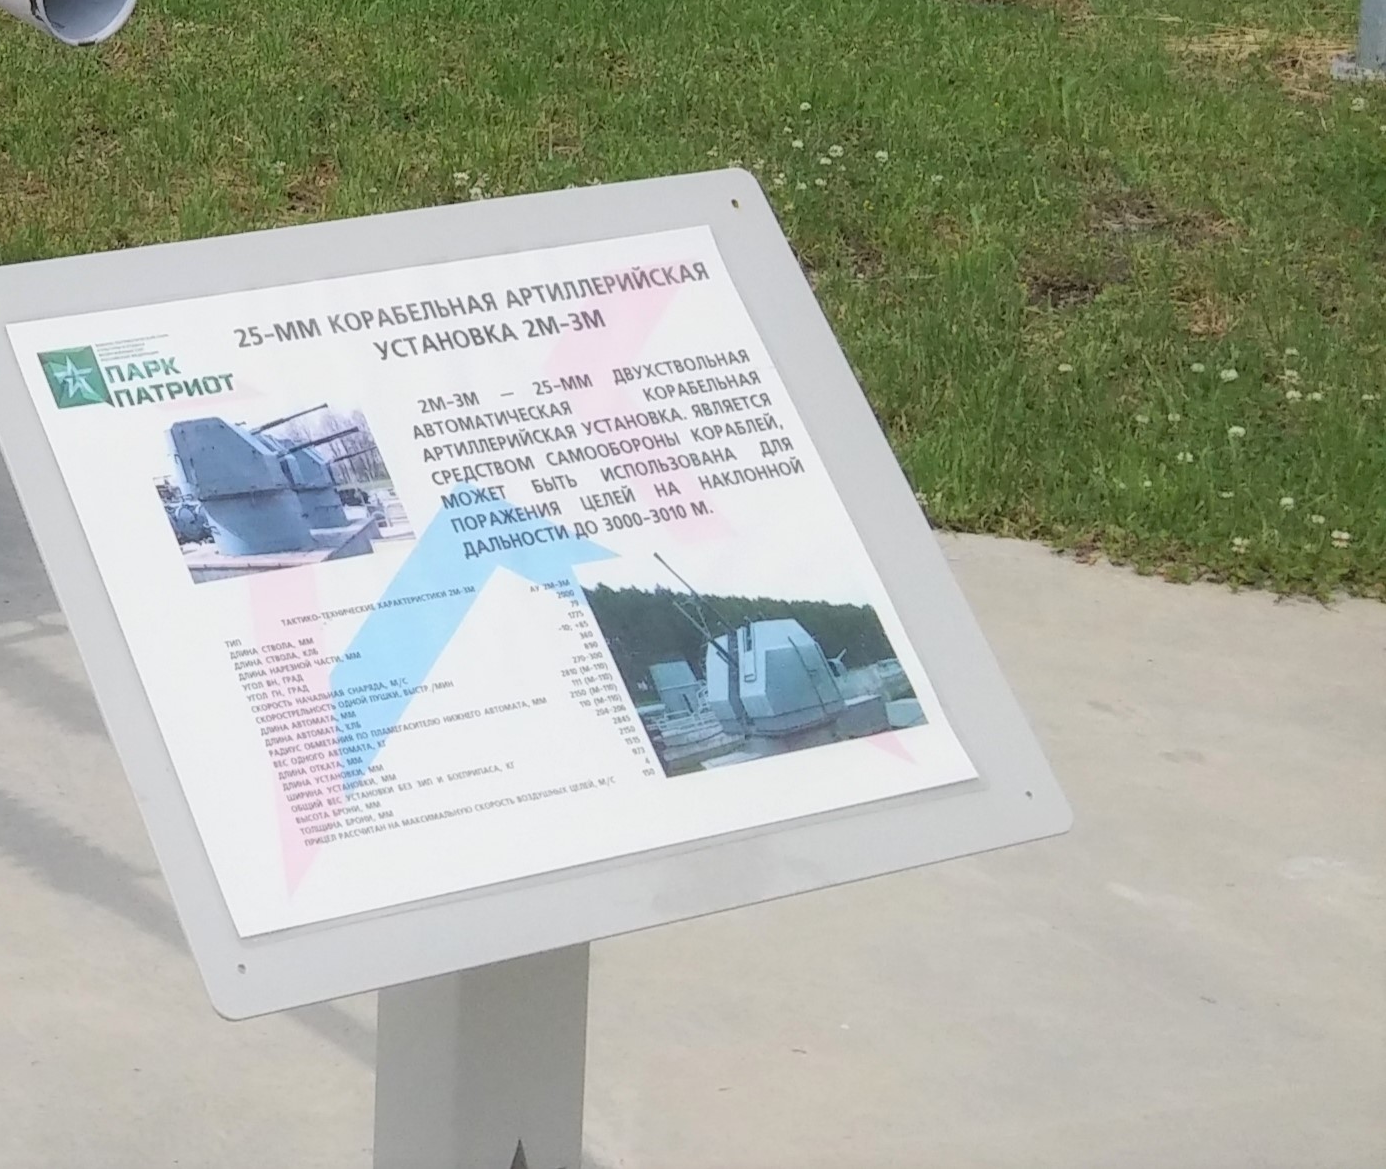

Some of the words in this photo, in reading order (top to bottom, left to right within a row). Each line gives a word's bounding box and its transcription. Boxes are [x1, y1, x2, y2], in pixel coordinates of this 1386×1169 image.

[233, 317, 323, 349] 25-ММ
[326, 291, 499, 334] КОРАБЕЛЬНАЯ
[506, 261, 711, 310] АРТИЛЛЕРИЙСКАЯ
[372, 322, 520, 361] УСТАНОВКА
[521, 308, 607, 339] 2М-3М
[104, 356, 182, 384] ПАРК
[113, 372, 234, 408] ПАТРИОТ
[413, 400, 573, 441] АВТОМАТИЧЕСКАЯ
[641, 369, 762, 403] КОРАБЕЛЬНАЯ
[416, 391, 481, 414] 2М-3М
[531, 373, 594, 396] 25-ММ
[611, 348, 751, 386] ДВУХСТВОЛЬНАЯ
[423, 423, 578, 464] АРТИЛЛЕРИЙСКАЯ
[580, 407, 688, 437] УСТАНОВКА.
[690, 392, 773, 419] ЯВЛЯЕТСЯ
[431, 455, 536, 486] СРЕДСТВОМ
[545, 431, 682, 467] САМООБОРОНЫ
[689, 411, 784, 443] КОРАБЛЕЙ,
[440, 484, 507, 510] МОЖЕТ
[530, 473, 578, 494] БЫТЬ
[599, 446, 738, 483] ИСПОЛЬЗОВАНА
[759, 436, 795, 459] ДЛЯ
[450, 500, 563, 534] ПОРАЖЕНИЯ
[578, 484, 637, 513] ЦЕЛЕЙ
[652, 480, 682, 499] НА
[697, 455, 806, 491] НАКЛОННОЙ
[462, 524, 570, 561] ДАЛЬНОСТИ
[573, 519, 599, 541] ДО
[601, 504, 688, 533] 3000-3010
[689, 500, 715, 517] М.
